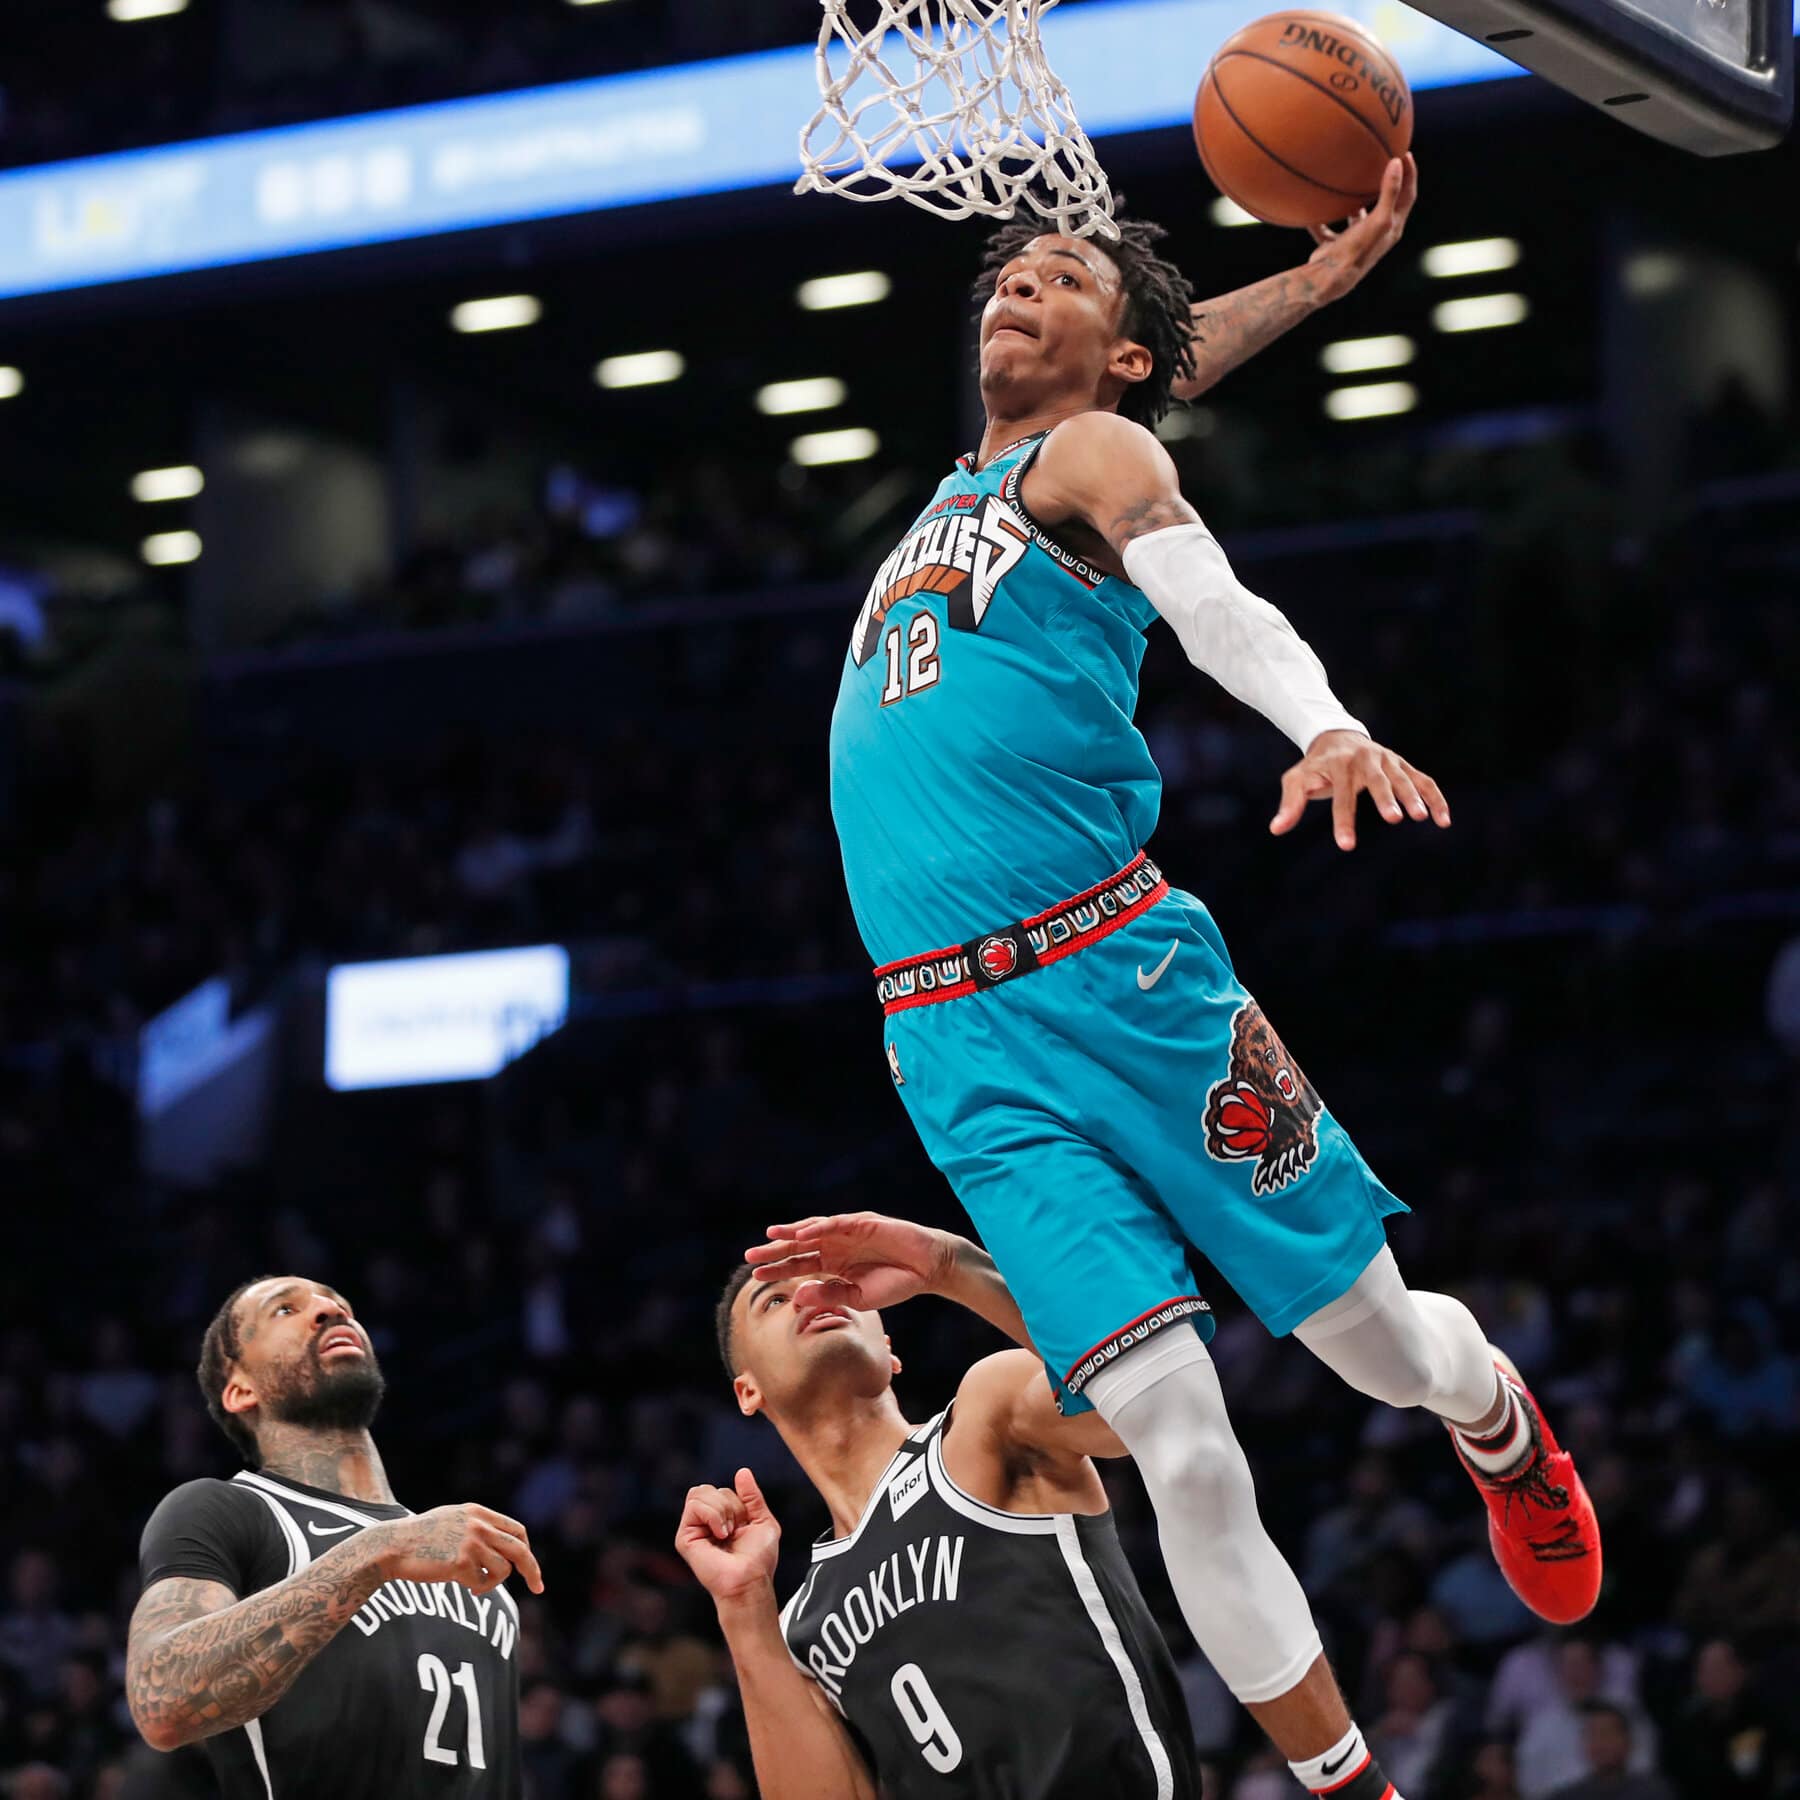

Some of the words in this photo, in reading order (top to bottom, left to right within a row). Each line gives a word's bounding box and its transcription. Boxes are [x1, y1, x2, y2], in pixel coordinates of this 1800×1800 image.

[880, 609, 940, 708] 12
[893, 1471, 922, 1504] infor
[809, 1536, 964, 1712] ROOKLYN
[417, 1653, 487, 1769] 21
[891, 1662, 962, 1774] 9
